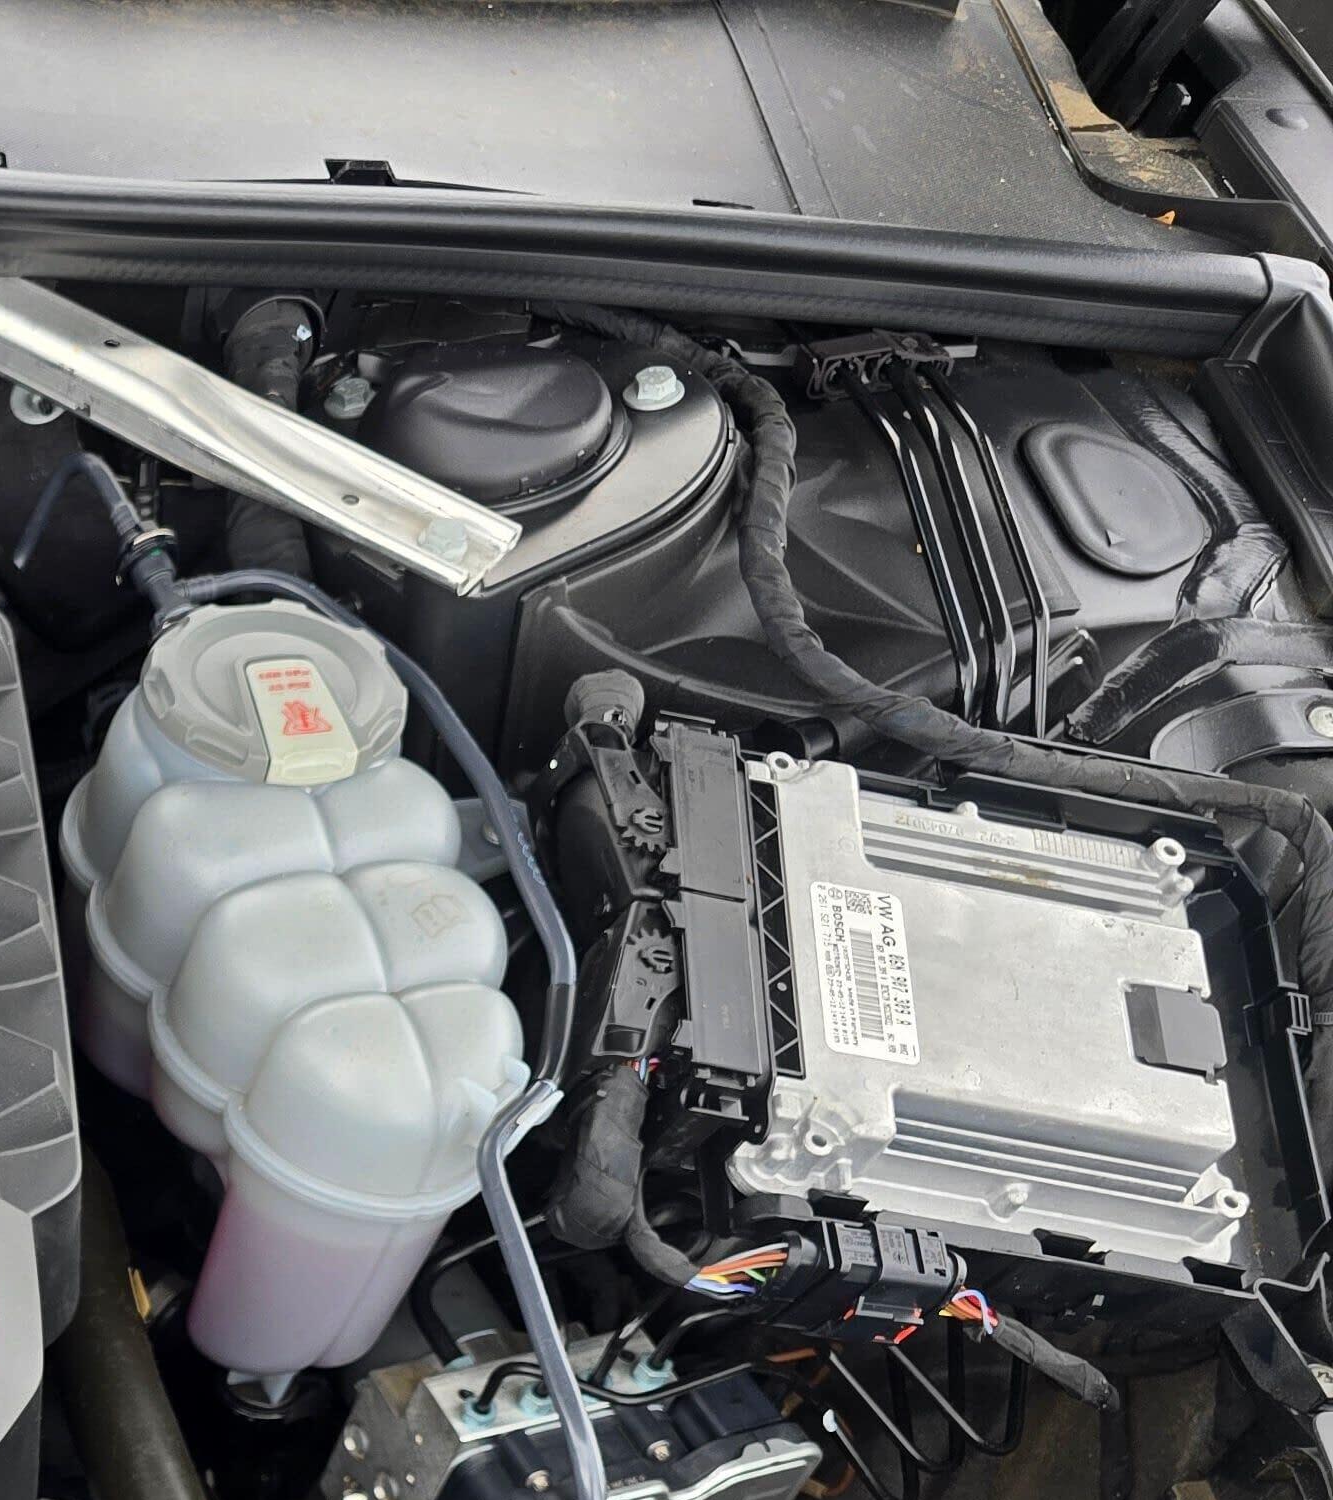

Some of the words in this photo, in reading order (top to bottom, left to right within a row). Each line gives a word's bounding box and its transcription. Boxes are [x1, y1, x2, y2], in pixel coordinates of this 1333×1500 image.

[876, 895, 894, 922] VW
[832, 905, 846, 943] BOSCH
[880, 924, 897, 948] AG
